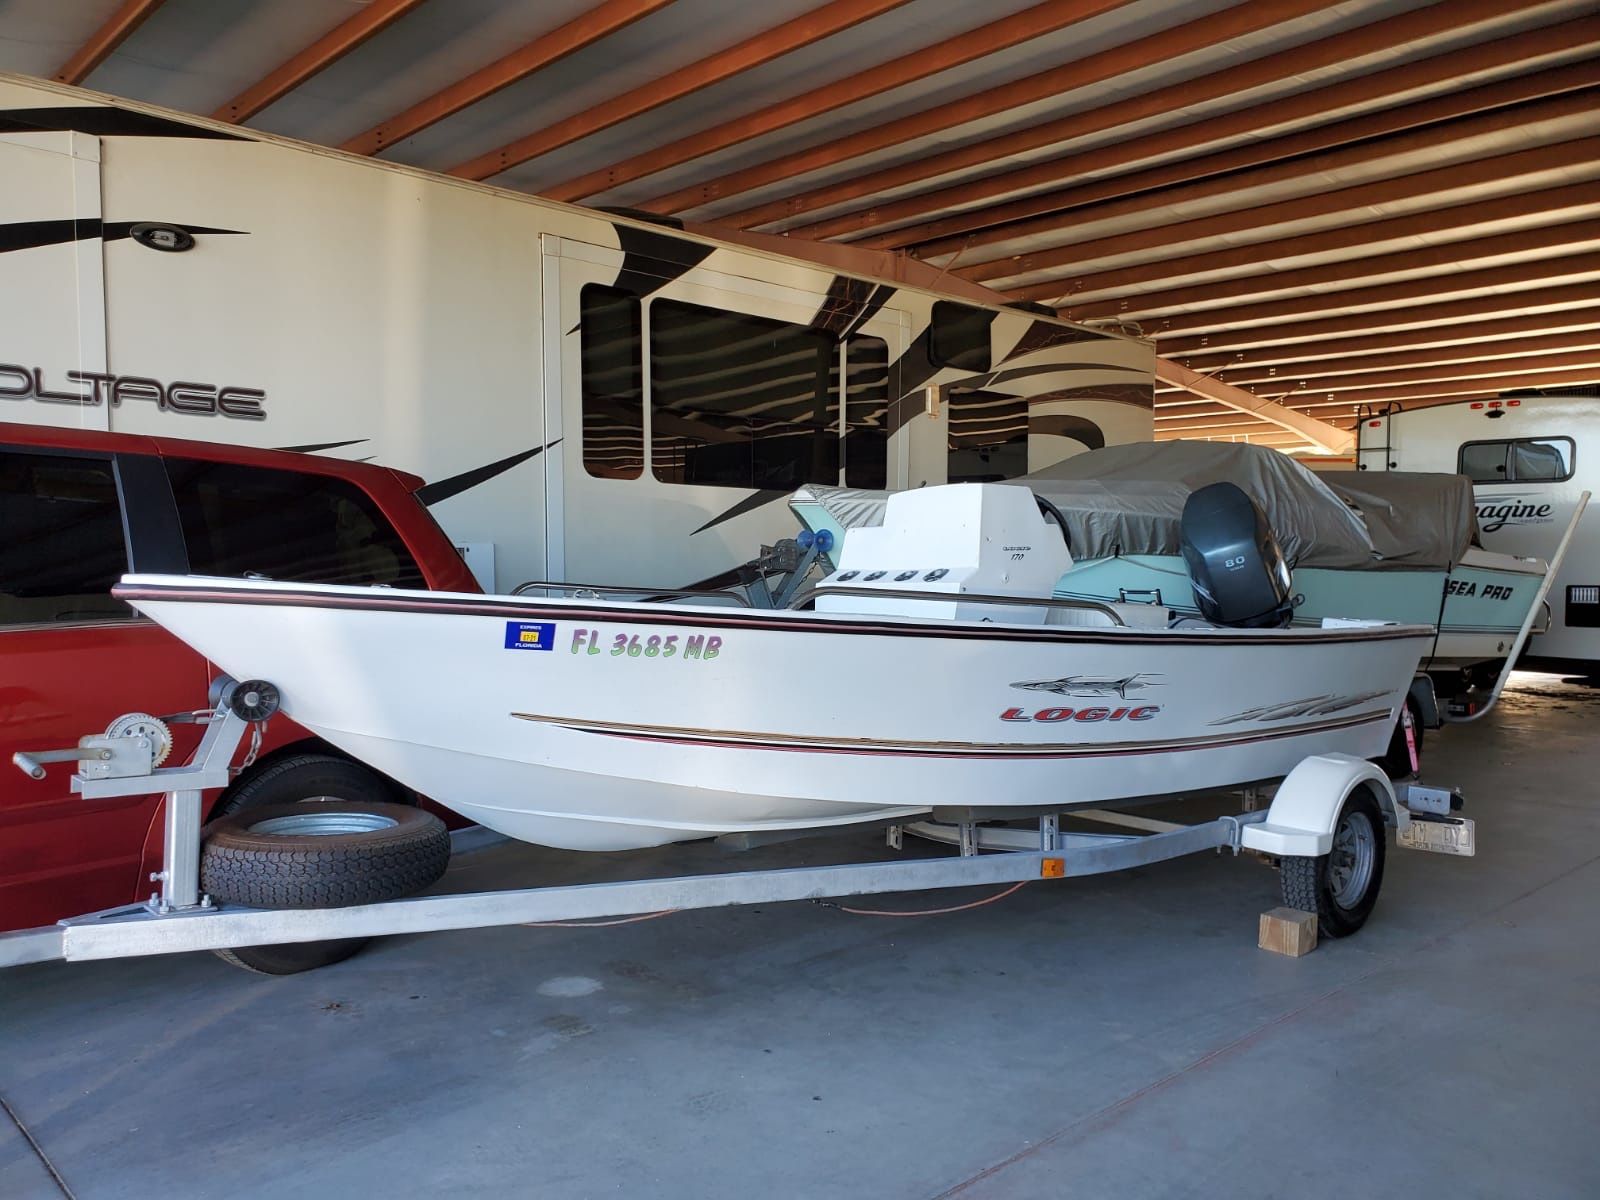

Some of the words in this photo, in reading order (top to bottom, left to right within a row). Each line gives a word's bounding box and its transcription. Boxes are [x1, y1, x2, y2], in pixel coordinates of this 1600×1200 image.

[1474, 500, 1554, 533] agine
[1225, 556, 1245, 568] 80
[1447, 580, 1477, 597] SEA
[1480, 584, 1514, 601] PRO
[571, 629, 601, 655] FL
[610, 633, 679, 658] 3685
[683, 634, 723, 660] MB
[999, 705, 1161, 723] LOGIC
